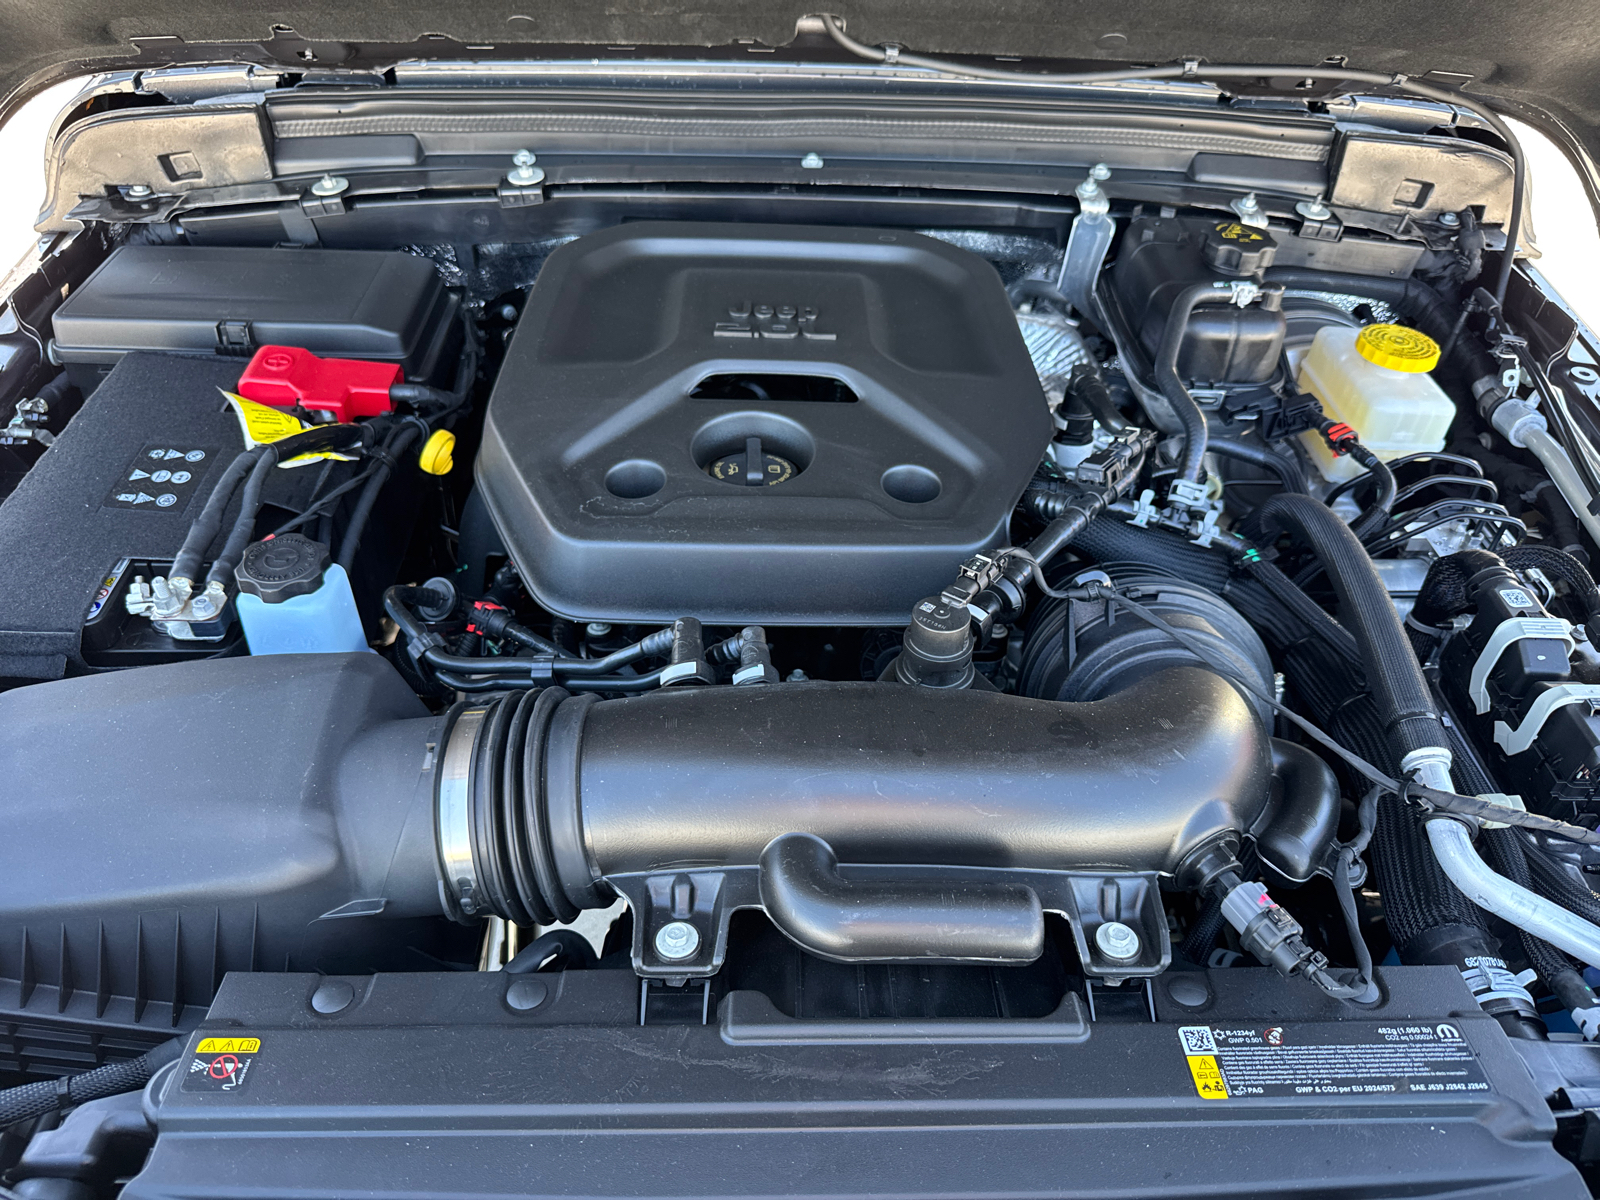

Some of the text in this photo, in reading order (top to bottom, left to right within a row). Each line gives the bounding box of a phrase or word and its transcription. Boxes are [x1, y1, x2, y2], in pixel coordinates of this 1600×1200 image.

[729, 300, 819, 324] Jeep
[714, 322, 837, 341] 2.0L
[1421, 1026, 1433, 1034] lb)
[1340, 1086, 1351, 1094] per
[1363, 1084, 1396, 1092] 2024/573
